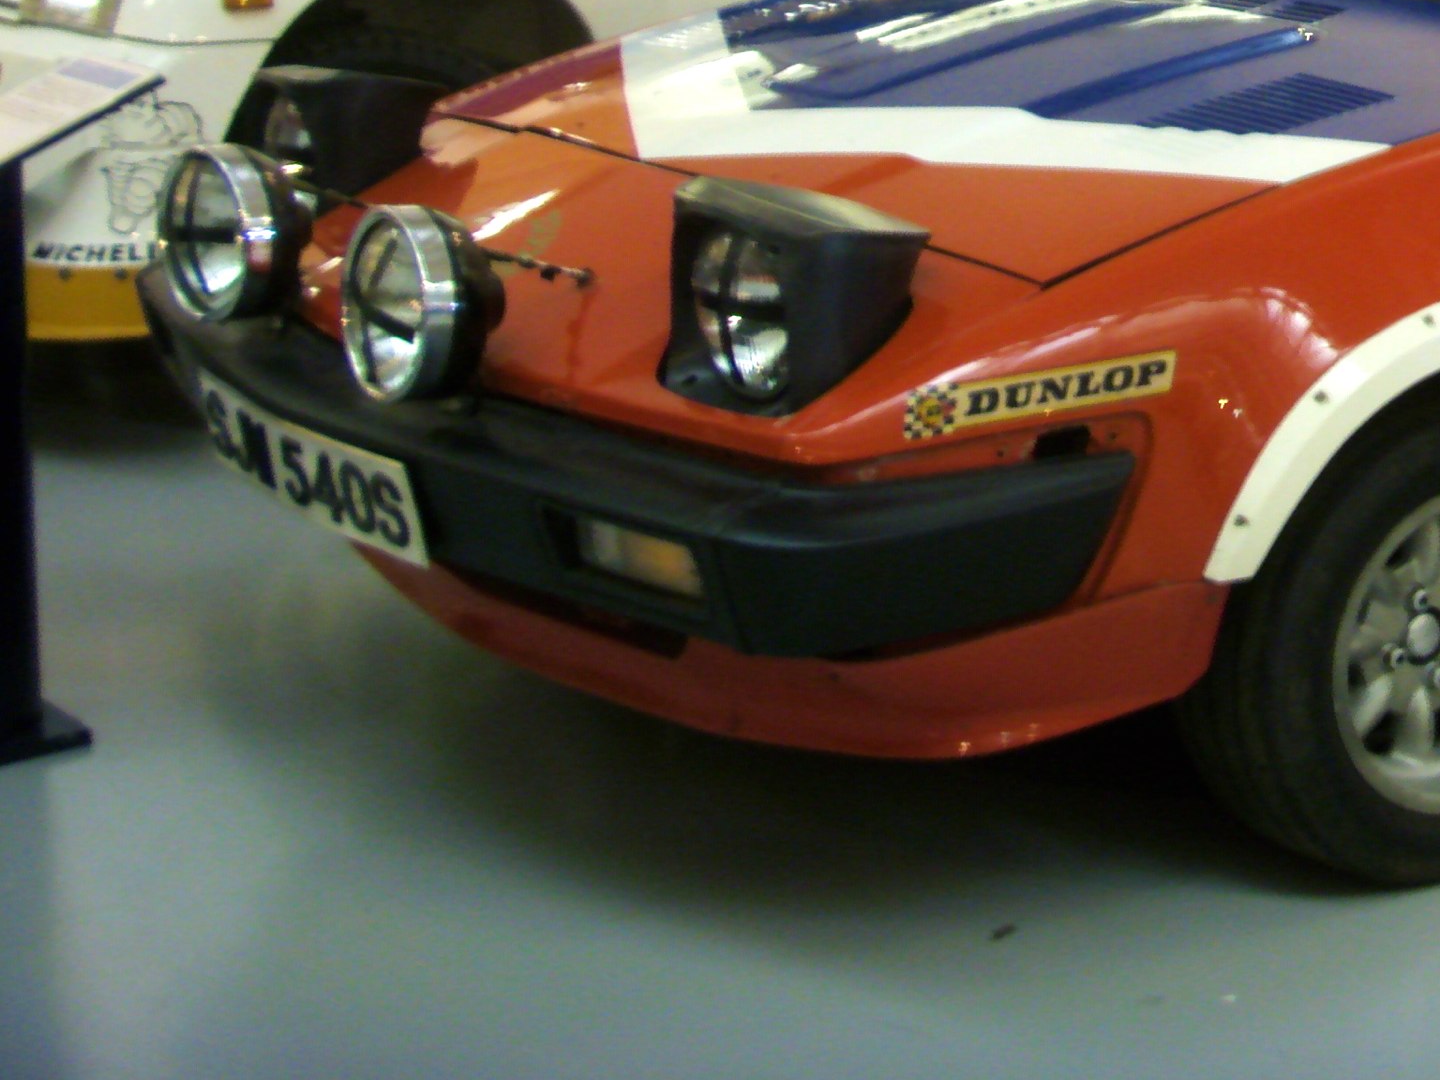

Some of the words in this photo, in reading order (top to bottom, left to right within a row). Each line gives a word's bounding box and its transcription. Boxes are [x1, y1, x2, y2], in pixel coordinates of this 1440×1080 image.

[32, 241, 157, 263] MICHELI
[965, 359, 1168, 416] DUNLOP
[280, 435, 411, 548] 540S
